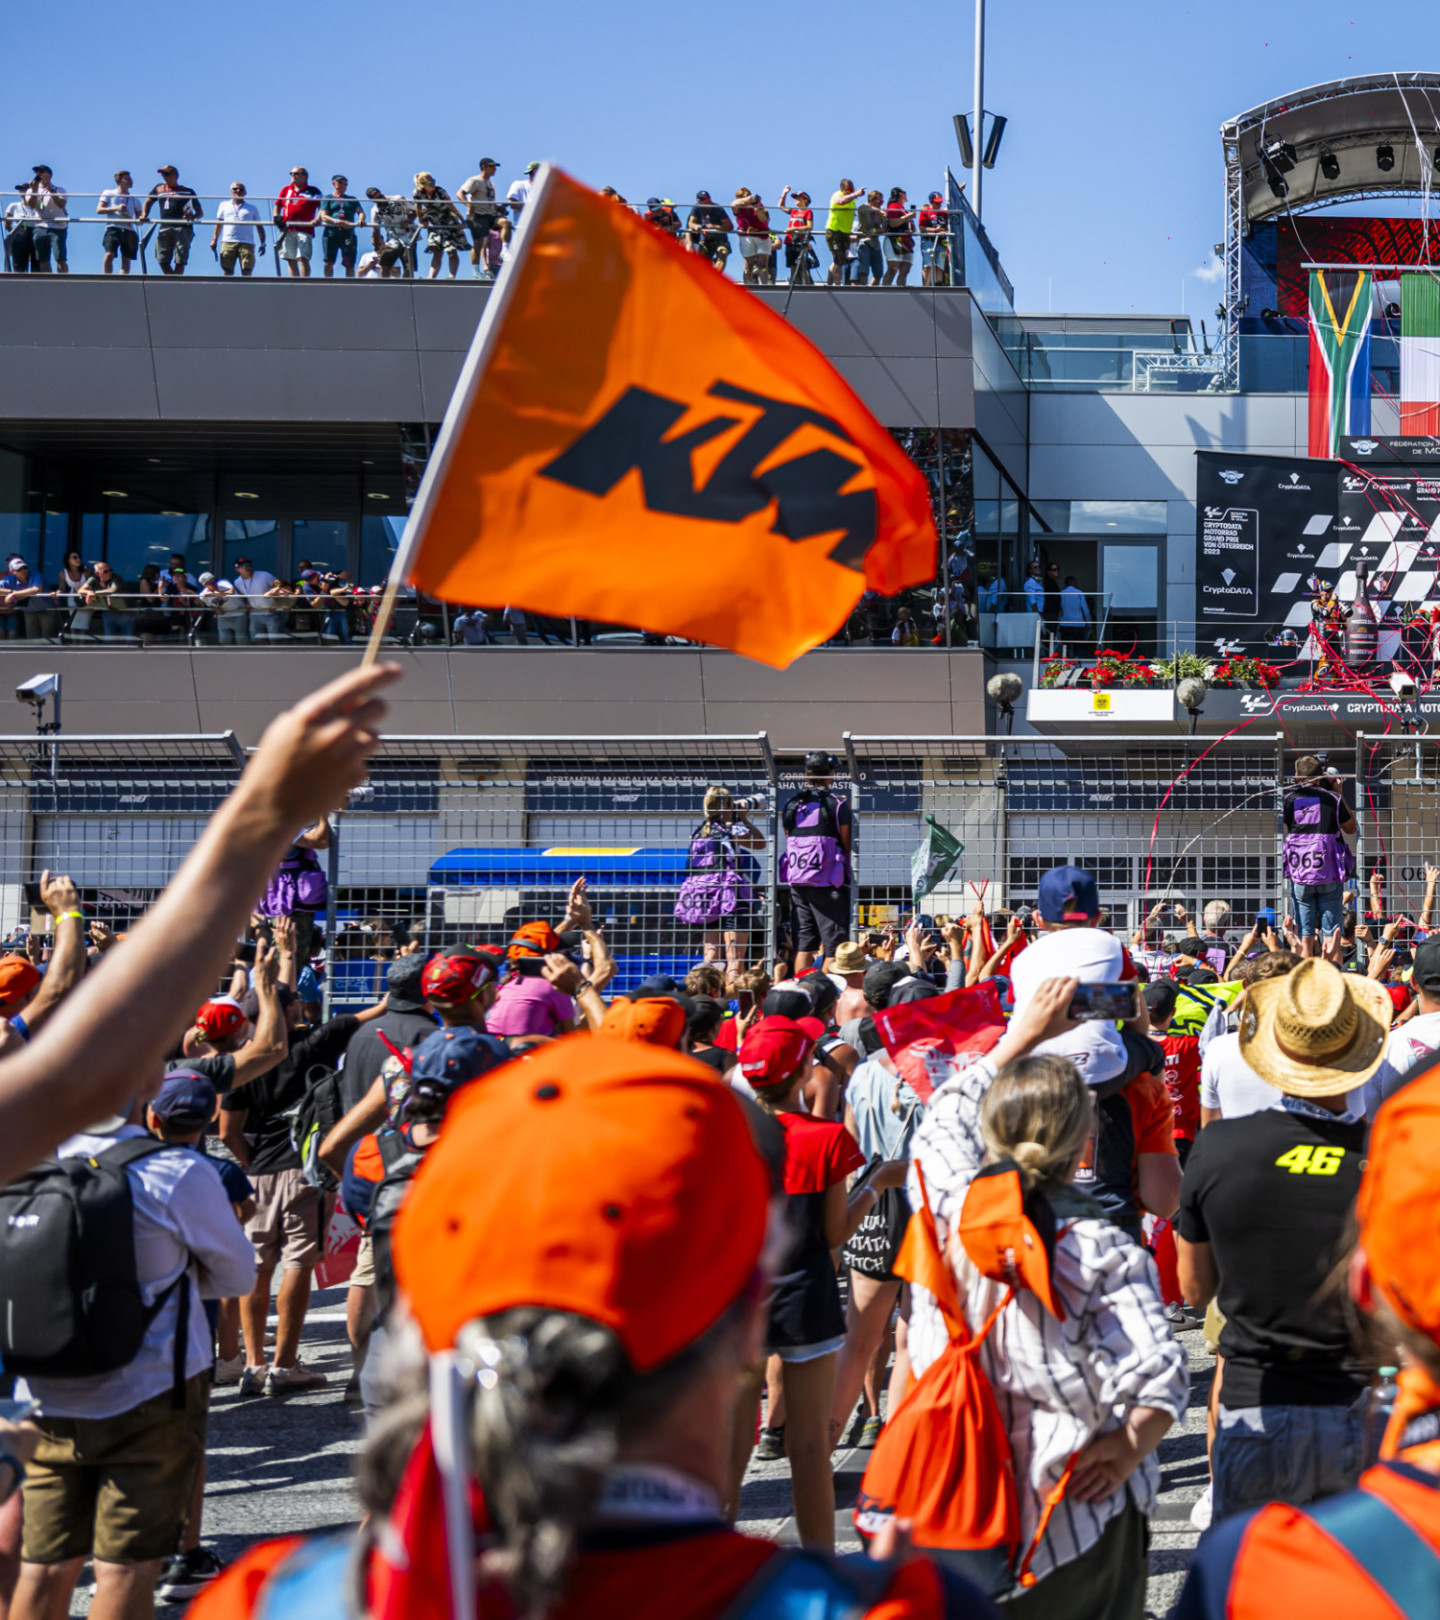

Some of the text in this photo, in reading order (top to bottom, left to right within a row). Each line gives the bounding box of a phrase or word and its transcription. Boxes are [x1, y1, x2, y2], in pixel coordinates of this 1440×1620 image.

[536, 378, 878, 574] KTM
[1278, 483, 1311, 491] CryptoDATA
[1204, 522, 1242, 530] CRYPTODATA
[1204, 528, 1238, 536] MOTORRAD
[1202, 585, 1253, 596] CryptoDATA
[1282, 703, 1333, 712] CryptoDATA
[788, 851, 822, 870] 064
[1288, 850, 1324, 869] 065
[1275, 1144, 1346, 1176] 46
